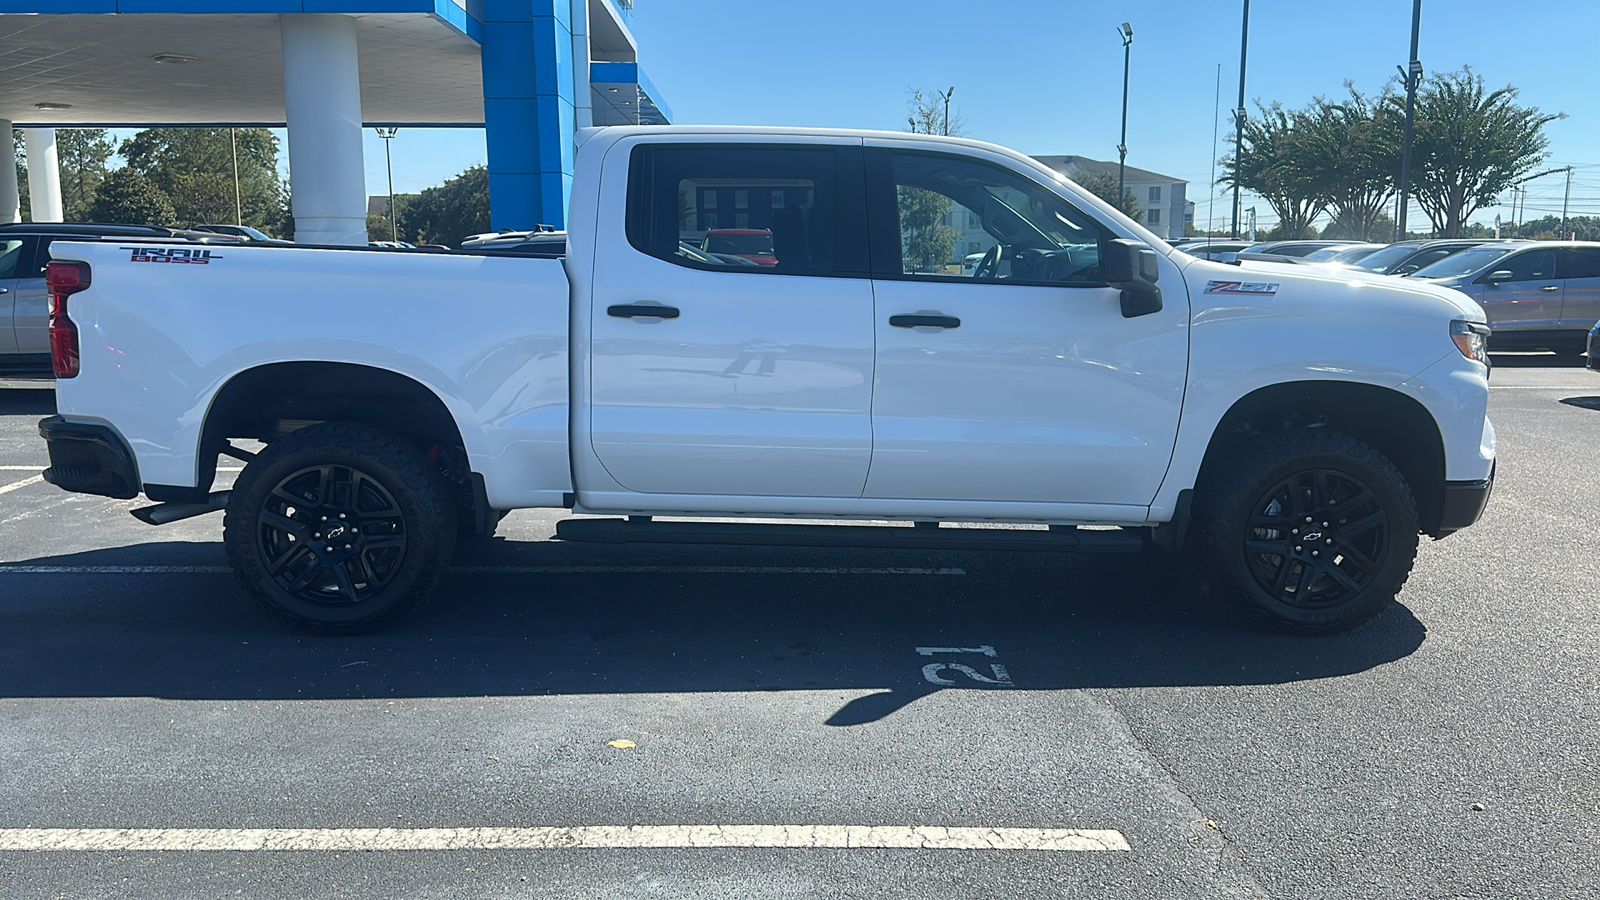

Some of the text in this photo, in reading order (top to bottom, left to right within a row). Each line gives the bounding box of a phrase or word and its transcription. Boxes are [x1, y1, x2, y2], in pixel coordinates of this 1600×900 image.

[119, 246, 223, 259] TRAIL
[130, 255, 210, 265] BOSS
[914, 645, 1015, 687] 21
